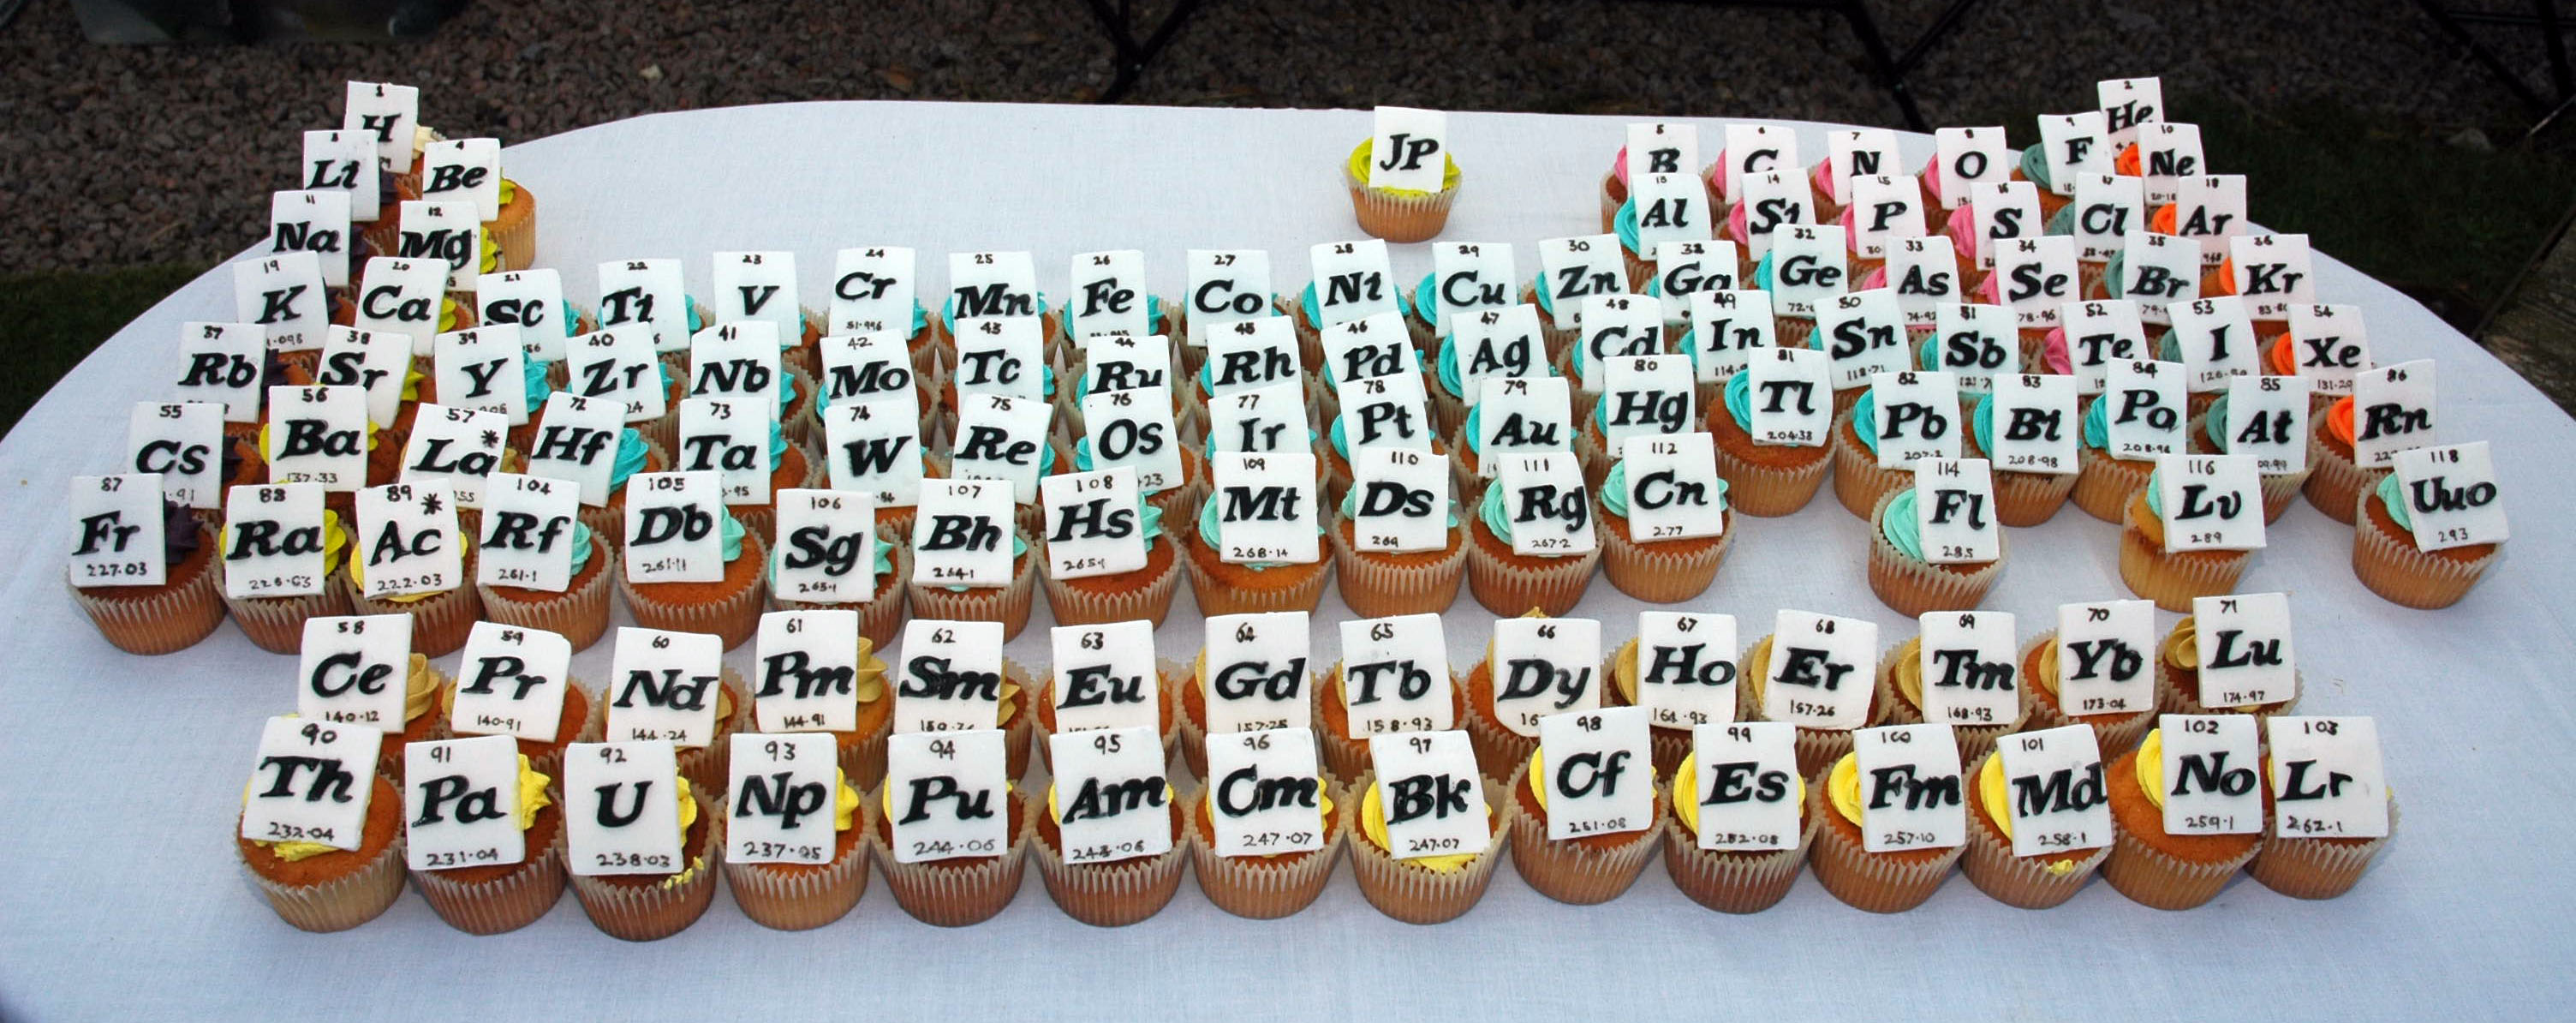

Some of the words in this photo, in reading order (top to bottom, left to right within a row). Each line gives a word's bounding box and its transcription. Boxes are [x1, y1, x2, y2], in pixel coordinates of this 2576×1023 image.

[362, 114, 401, 143] H
[2106, 100, 2153, 134] He
[1380, 134, 1439, 171] JP
[1649, 148, 1680, 173] B
[1744, 149, 1778, 173] C
[1851, 151, 1881, 176] N
[1955, 151, 1987, 179] O
[2066, 137, 2093, 165] F
[2149, 149, 2194, 176] Ne
[306, 159, 360, 190] Li
[425, 165, 487, 192] Be
[1641, 198, 1688, 228] Al
[1750, 199, 1799, 233] Si
[1869, 201, 1907, 231] P
[1989, 208, 2022, 239] S
[2082, 204, 2128, 236] Cl
[2180, 213, 2233, 237] Ar
[399, 230, 473, 271] Mg
[866, 249, 884, 258] 24
[1214, 254, 1236, 266] 27
[1335, 243, 1353, 254] 28
[1569, 240, 1589, 252] 30
[1906, 241, 1923, 252] 33
[264, 260, 279, 273] 19
[392, 261, 409, 271] 20
[1556, 265, 1620, 299] Zn
[1780, 255, 1841, 287] Ge
[2009, 262, 2067, 302] Se
[2243, 264, 2303, 296] Kr
[363, 285, 431, 322] Ca
[738, 285, 779, 315] V
[836, 272, 897, 301] Cr
[1080, 278, 1134, 317] Fe
[1195, 279, 1263, 314] Co
[1325, 272, 1382, 307] Ni
[1839, 296, 1861, 308] 50
[254, 285, 307, 324] K
[2192, 300, 2214, 314] 53
[2314, 305, 2334, 317] 54
[348, 331, 371, 344] 38
[719, 326, 736, 341] 41
[848, 338, 873, 350] 42
[1831, 317, 1897, 361] Sn
[2209, 325, 2230, 362] I
[1343, 343, 1404, 382] Pd
[1470, 335, 1530, 378] Ag
[2304, 337, 2360, 368] Xe
[320, 352, 388, 391] Sr
[461, 358, 508, 398] Y
[582, 358, 648, 397] Zr
[829, 361, 909, 399] Mo
[1898, 372, 1918, 385] 82
[160, 405, 182, 418] 55
[446, 408, 474, 422] 57
[711, 402, 730, 420] 73
[1239, 395, 1260, 410] 77
[1609, 391, 1688, 434] Hg
[1760, 380, 1816, 416] Tl
[2114, 389, 2179, 428] Po
[1880, 403, 1947, 440] Pb
[2358, 403, 2432, 441] Rn
[277, 419, 361, 461] Ba
[533, 426, 612, 465] Hf
[685, 434, 757, 471] Ta
[843, 436, 912, 477] W
[1652, 443, 1677, 454] 112
[2431, 450, 2459, 463] 118
[136, 440, 209, 476] Cs
[1243, 458, 1265, 470] 109
[2189, 460, 2215, 475] 116
[101, 477, 122, 492] 87
[517, 478, 551, 494] 104
[1076, 476, 1112, 493] 108
[1358, 481, 1434, 517] Ds
[1634, 470, 1708, 510] Cn
[2410, 476, 2496, 513] Uuo
[812, 497, 841, 509] 106
[1223, 487, 1301, 522] Mt
[1514, 485, 1587, 533] Rg
[1929, 489, 1985, 530] Fl
[2175, 485, 2241, 520] Lv
[72, 511, 140, 555] Fr
[481, 512, 571, 553] Rf
[630, 503, 713, 547] Db
[1048, 499, 1134, 542] Hs
[2191, 532, 2221, 543] 289
[2438, 528, 2468, 542] 293
[226, 520, 324, 560] Ra
[1943, 546, 1973, 558] 285
[2221, 600, 2237, 613] 71
[338, 620, 364, 634] 58
[787, 619, 802, 633] 61
[1371, 623, 1393, 641] 65
[1678, 617, 1697, 632] 67
[653, 636, 669, 649] 60
[2067, 638, 2143, 682] Yb
[2207, 630, 2282, 669] Lu
[312, 651, 392, 698] Ce
[756, 651, 854, 698] Pm
[1215, 658, 1306, 702] Gd
[1645, 643, 1736, 685] Ho
[1774, 648, 1854, 691] Er
[1934, 649, 2014, 691] Tm
[612, 669, 719, 711] Nd
[1056, 664, 1145, 709] Eu
[1497, 659, 1590, 709] Dy
[2022, 738, 2043, 751] 101
[2185, 720, 2219, 734] 102
[431, 746, 450, 763] 91
[765, 741, 795, 761] 93
[1410, 738, 1431, 754] 97
[259, 756, 353, 803] Th
[1218, 764, 1318, 817] Cm
[1557, 751, 1631, 799] Cf
[1701, 762, 1789, 806] Es
[1869, 764, 1961, 811] Fm
[2012, 762, 2108, 818] Md
[2171, 751, 2256, 797] No
[2276, 760, 2352, 802] Lr
[412, 775, 507, 828] Pa
[595, 781, 653, 828] U
[736, 772, 826, 829] Np
[899, 776, 993, 825] Pu
[1062, 776, 1166, 824] Am
[1386, 774, 1470, 825] Bk
